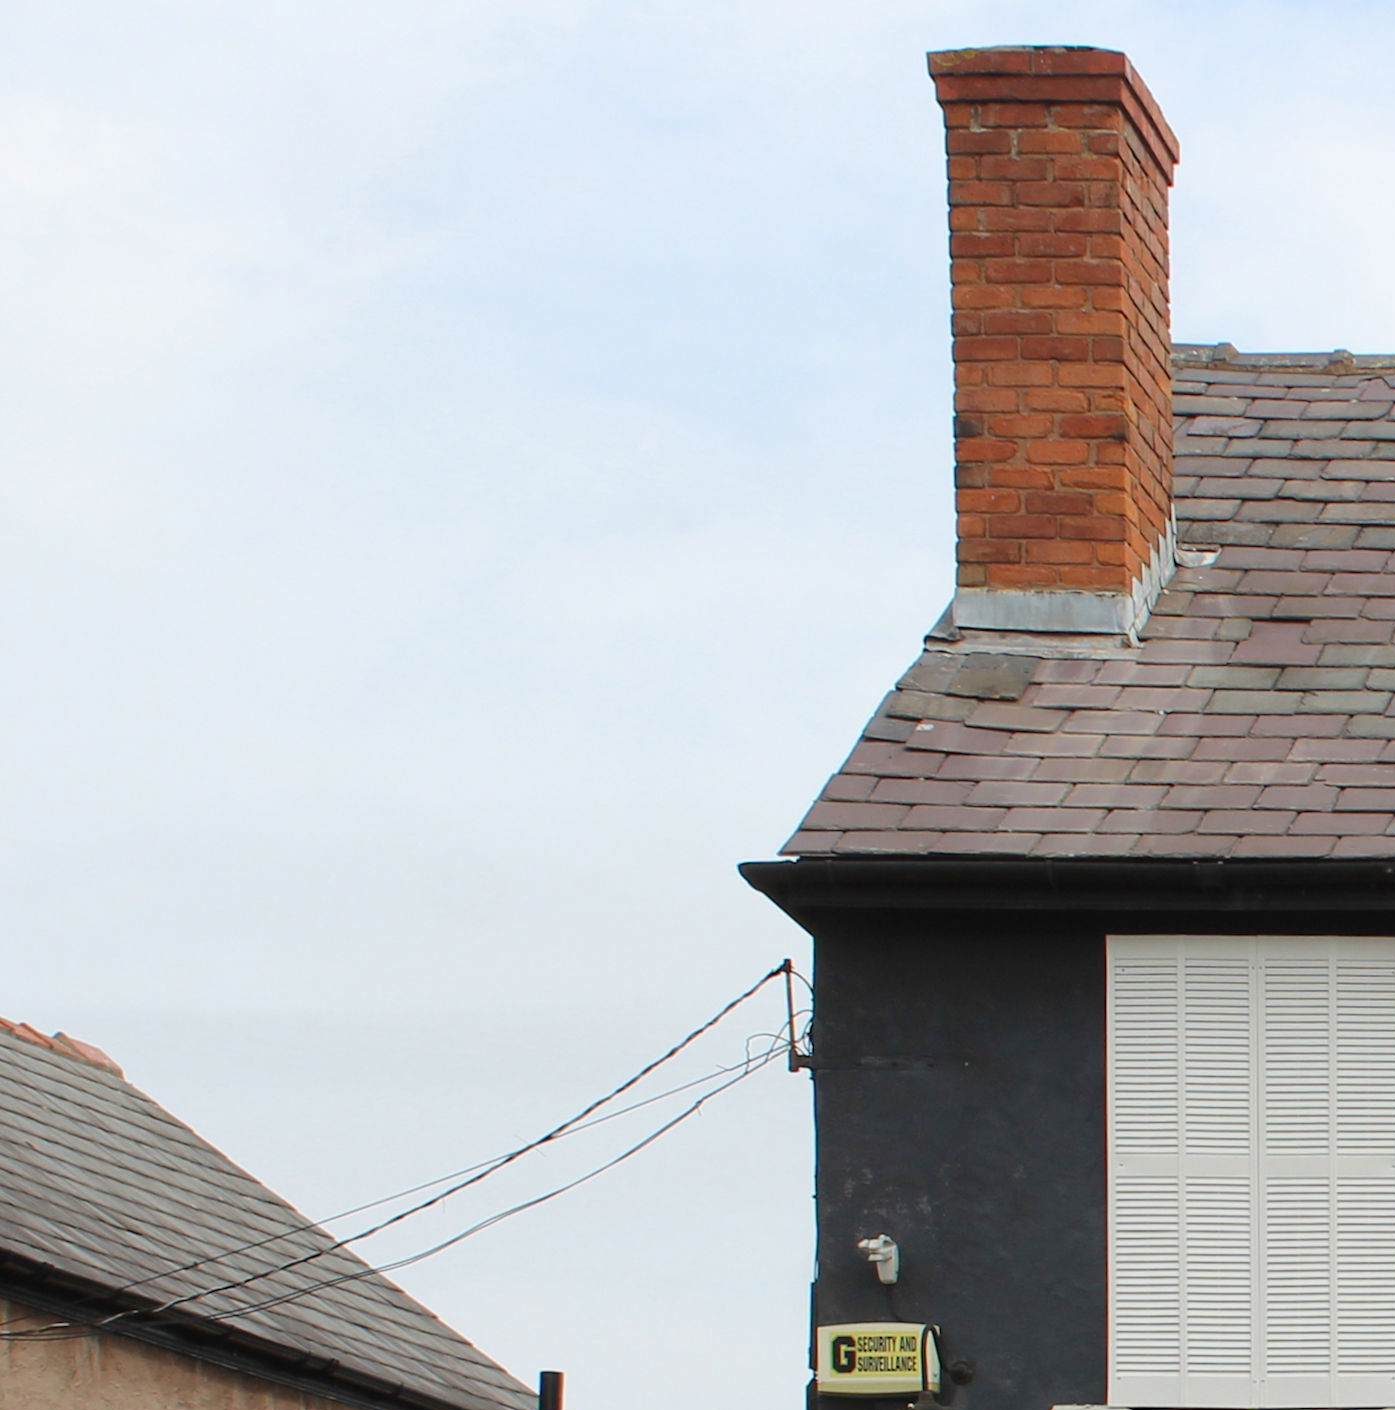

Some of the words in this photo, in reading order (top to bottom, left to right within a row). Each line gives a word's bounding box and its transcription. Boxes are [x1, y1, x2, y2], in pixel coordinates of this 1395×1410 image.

[857, 1336, 898, 1352] SECURITY
[900, 1336, 917, 1352] AND
[832, 1336, 856, 1373] G
[857, 1356, 917, 1372] SURVEILLANCE
